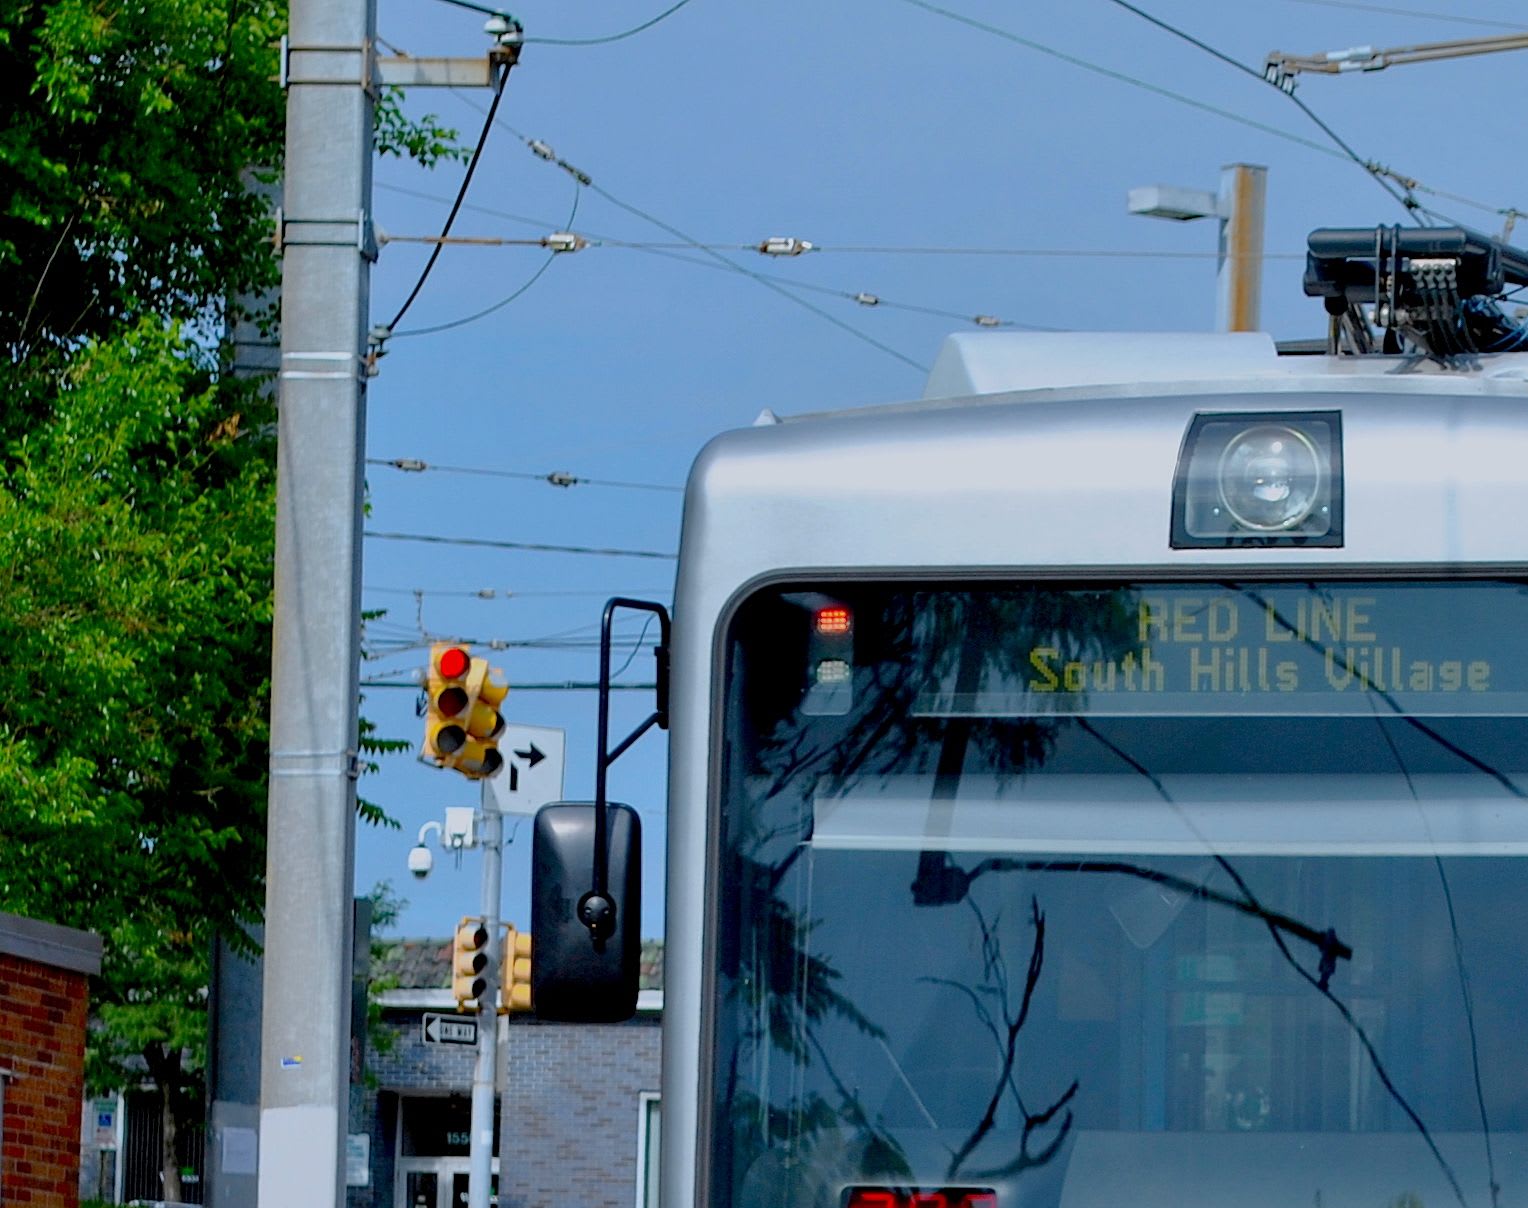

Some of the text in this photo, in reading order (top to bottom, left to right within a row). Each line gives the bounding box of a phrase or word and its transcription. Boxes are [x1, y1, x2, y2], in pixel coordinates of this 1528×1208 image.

[1138, 597, 1377, 641] RED LINE
[1029, 647, 1491, 692] South Hills Village
